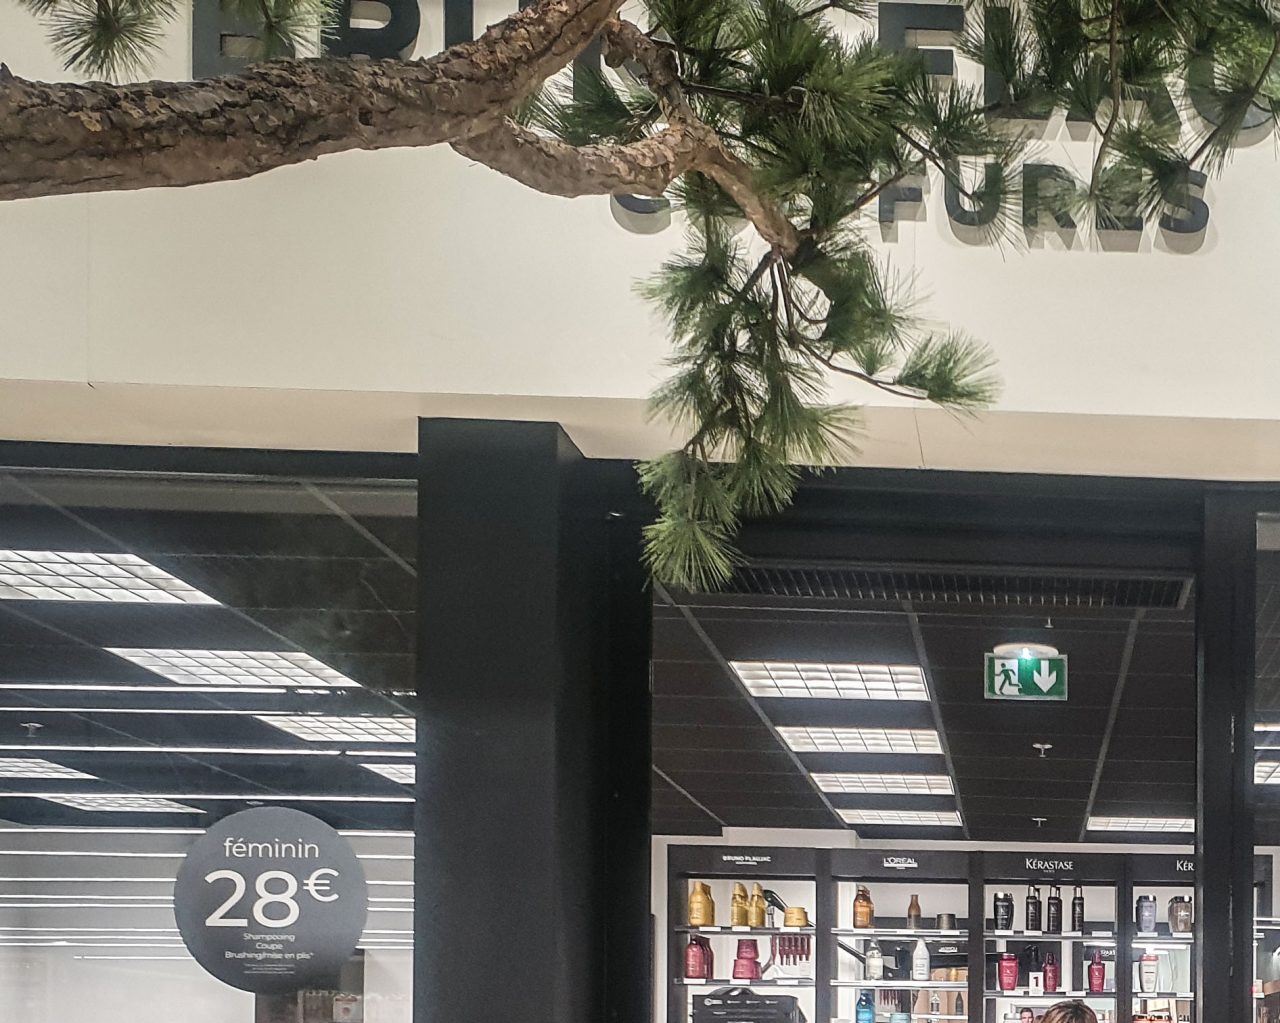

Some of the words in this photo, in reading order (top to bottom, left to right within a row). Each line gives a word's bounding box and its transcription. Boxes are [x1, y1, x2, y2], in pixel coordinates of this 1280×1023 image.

[224, 838, 319, 858] féminin
[1025, 858, 1073, 870] KÉRASTASE
[204, 868, 339, 928] 28€
[243, 933, 296, 943] Shampooing
[256, 942, 283, 951] Coupe
